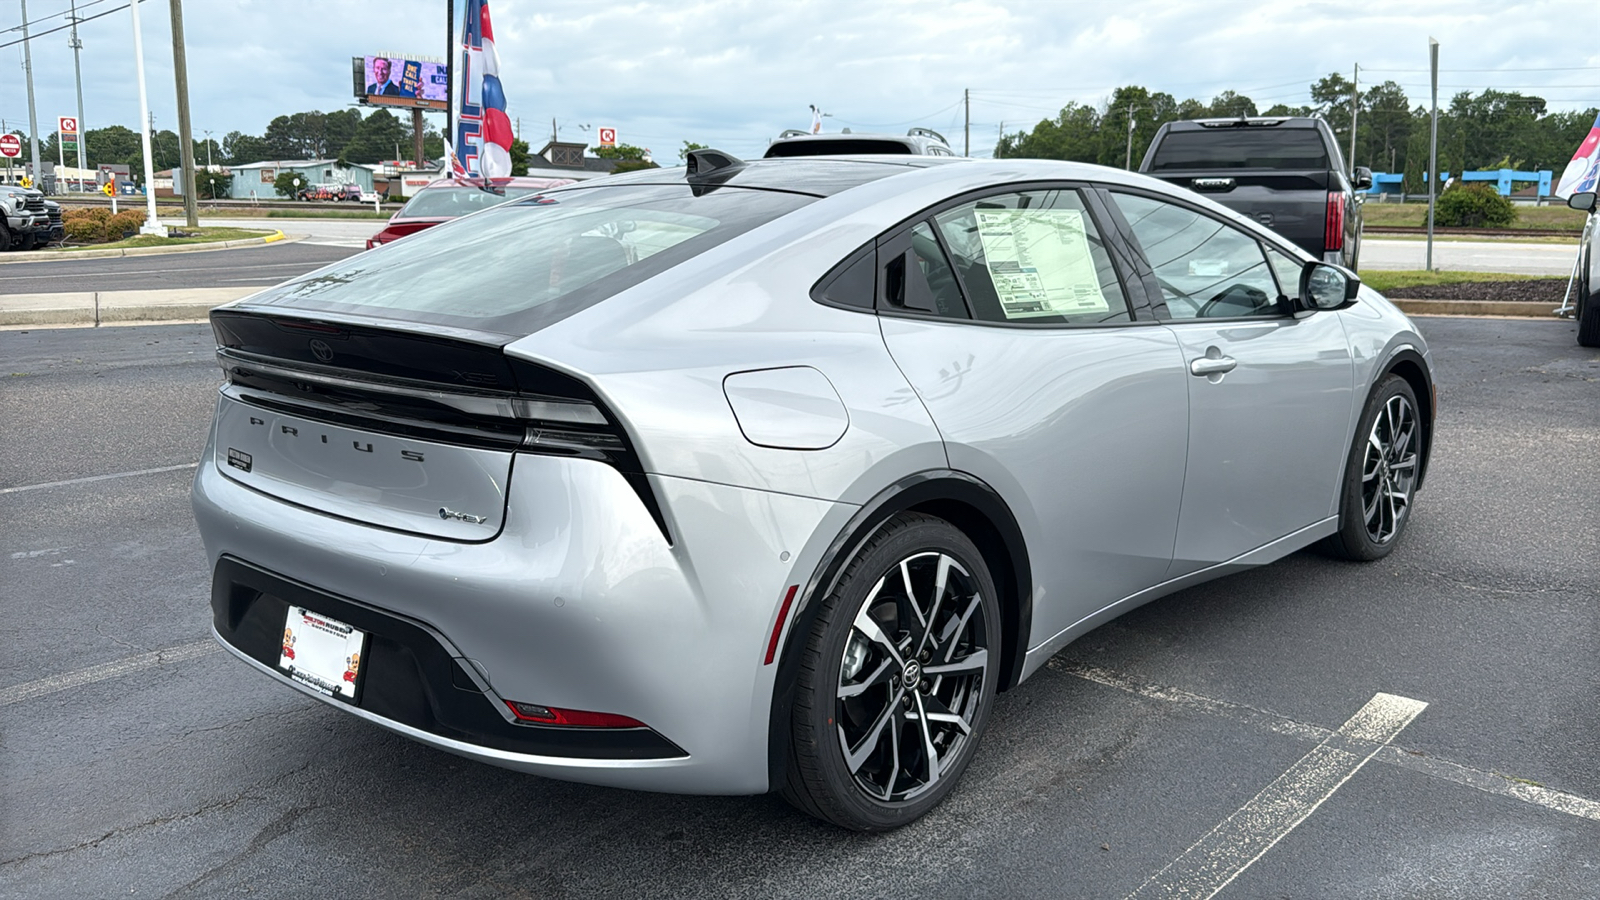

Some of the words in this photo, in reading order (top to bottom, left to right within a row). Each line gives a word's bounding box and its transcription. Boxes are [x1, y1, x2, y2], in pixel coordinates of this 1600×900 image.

[407, 64, 418, 73] ONE
[405, 70, 417, 80] CALL
[403, 77, 417, 88] THAT'S
[452, 370, 498, 384] XSE
[250, 417, 424, 462] PRIUS
